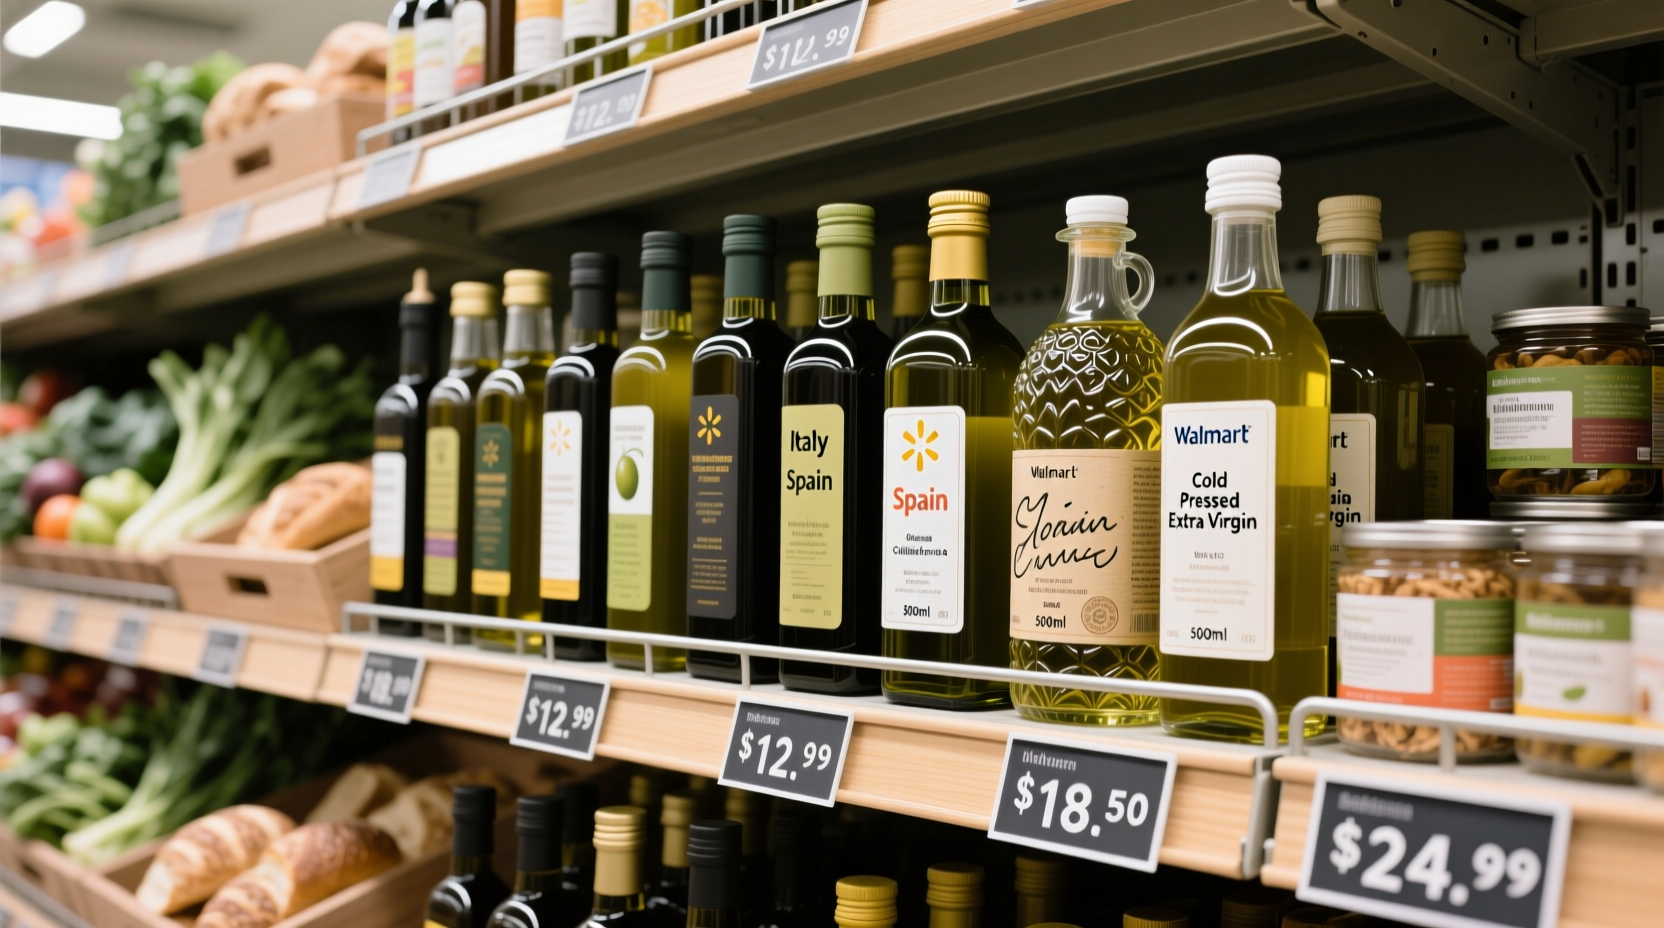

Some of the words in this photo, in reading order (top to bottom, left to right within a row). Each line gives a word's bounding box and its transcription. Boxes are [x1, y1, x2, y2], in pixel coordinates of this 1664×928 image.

[790, 430, 829, 458] Italy
[1174, 424, 1250, 445] Walmart
[786, 469, 833, 496] Spain
[1192, 471, 1228, 489] Cold
[892, 486, 949, 517] Spain
[1180, 491, 1240, 509] Pressed
[1168, 511, 1205, 530] Extra
[1207, 511, 1258, 534] Virgin
[1035, 615, 1067, 629] 500ml
[1190, 626, 1228, 642] 500ml
[525, 693, 596, 740] $12.99
[738, 727, 833, 782] $12.99
[1013, 770, 1150, 838] $18.50
[1328, 816, 1543, 907] $24.99
